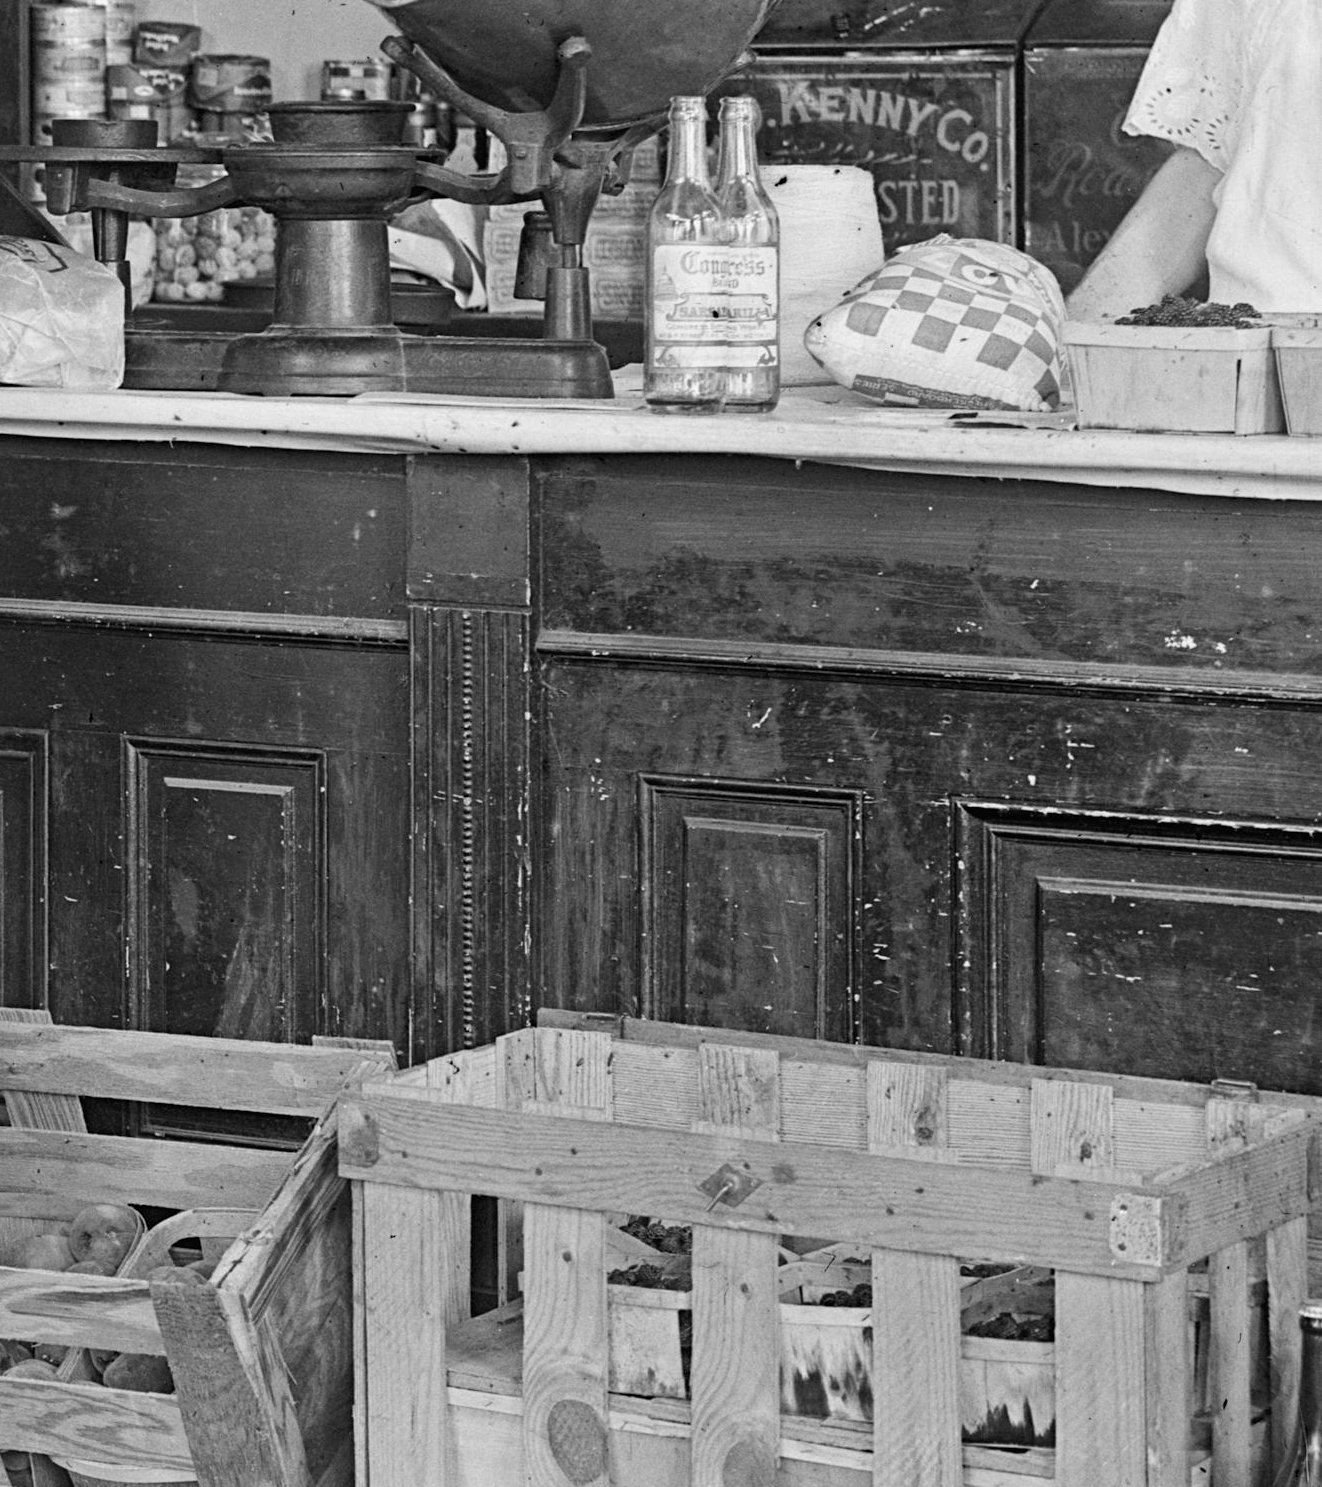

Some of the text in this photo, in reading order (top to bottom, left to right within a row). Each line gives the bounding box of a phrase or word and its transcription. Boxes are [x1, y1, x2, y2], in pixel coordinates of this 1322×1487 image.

[775, 80, 942, 137] KENNY
[1042, 141, 1136, 210] Roa
[879, 179, 960, 226] STED
[680, 250, 767, 278] Congress
